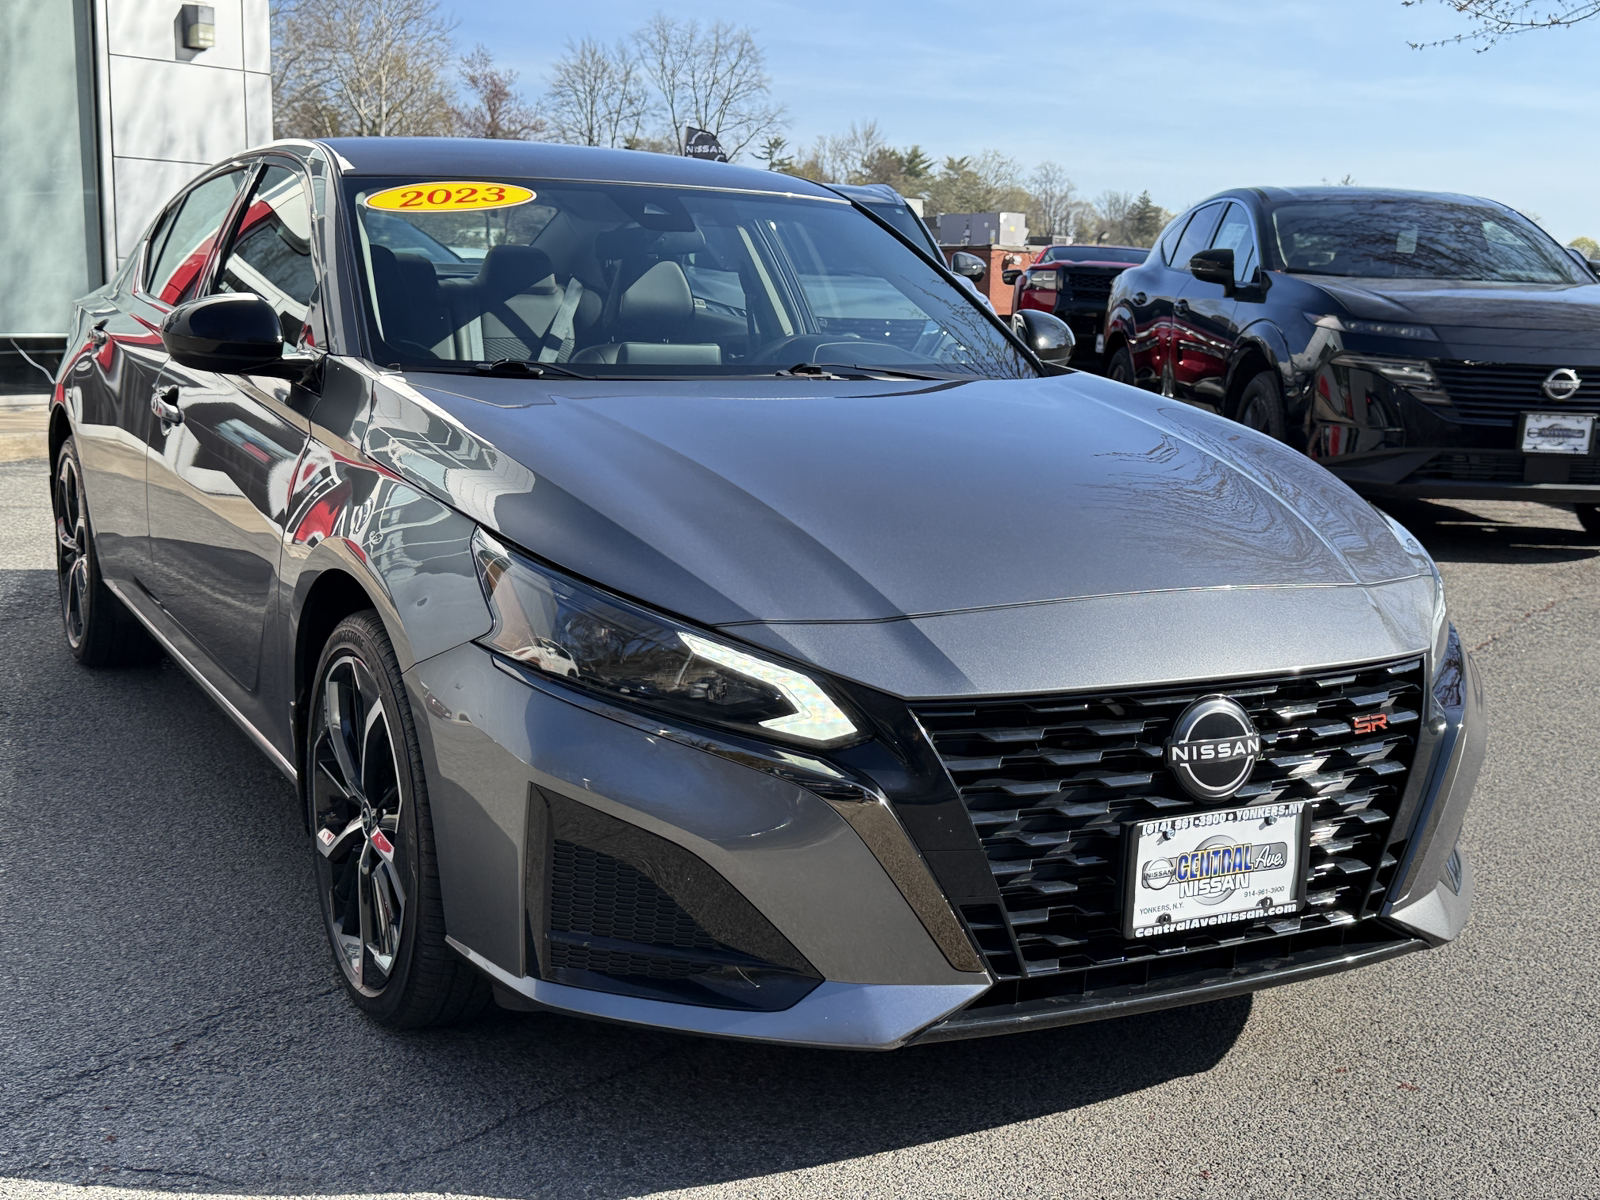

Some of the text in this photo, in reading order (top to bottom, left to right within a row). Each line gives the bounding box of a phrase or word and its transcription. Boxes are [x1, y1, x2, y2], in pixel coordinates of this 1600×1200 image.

[399, 187, 506, 208] 2023
[1353, 713, 1388, 735] SR
[1172, 738, 1260, 761] NISSAN
[1146, 869, 1174, 878] NISSAN
[1176, 843, 1284, 882] CENTRAL Ave.
[1179, 873, 1250, 899] NISSAN
[1244, 885, 1285, 898] 914-961-3900
[1135, 903, 1297, 939] CentralAveNissan.com
